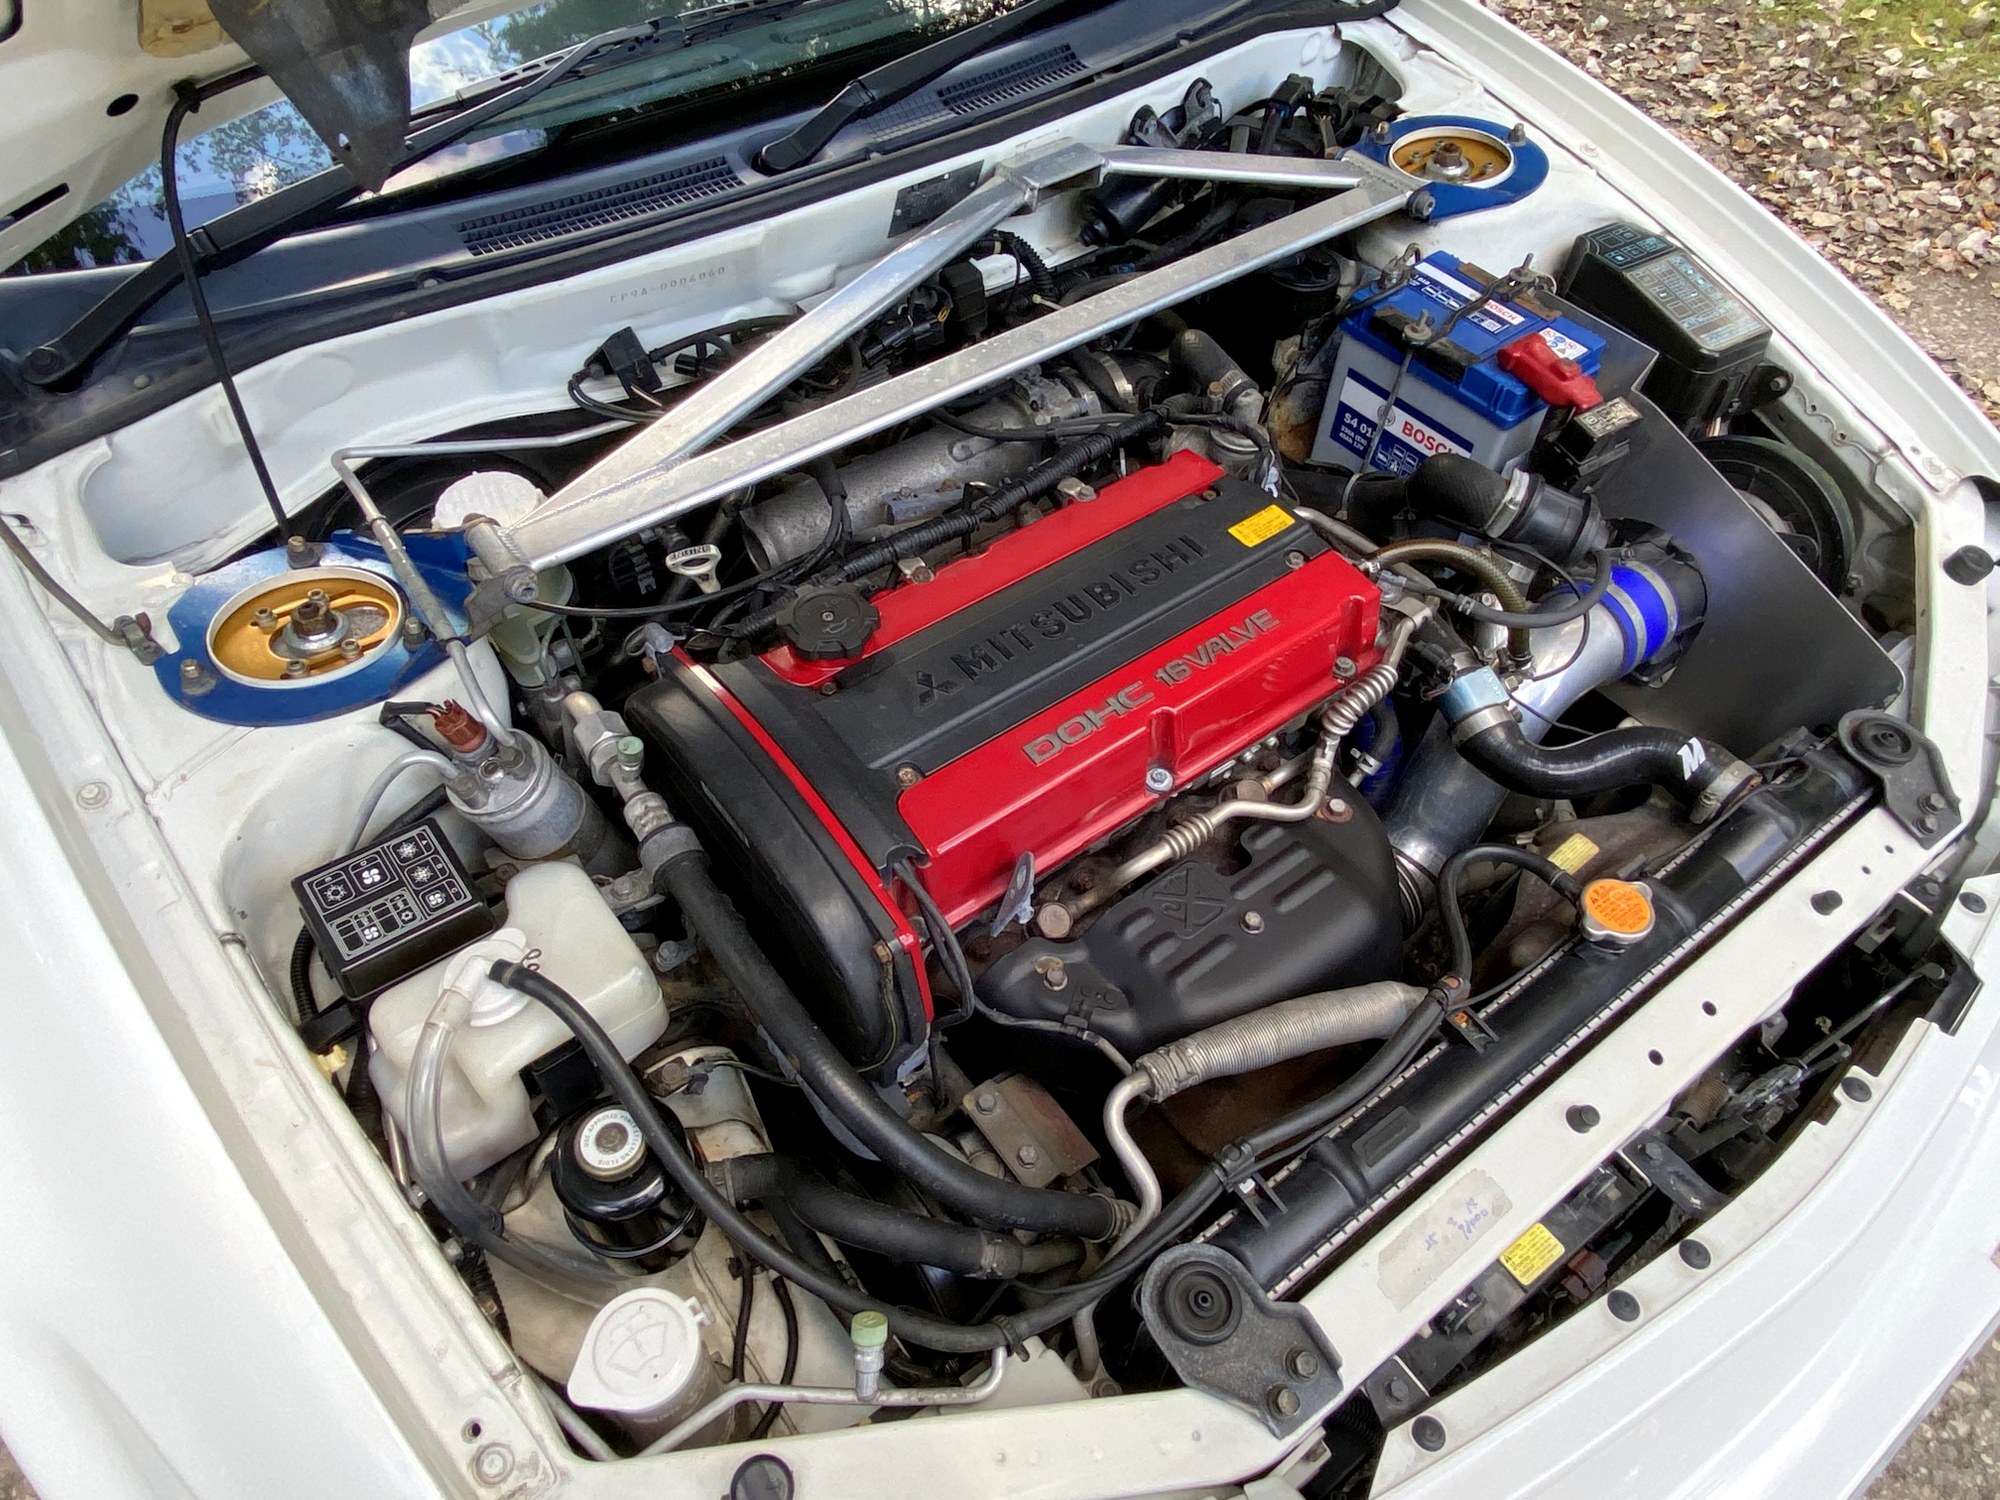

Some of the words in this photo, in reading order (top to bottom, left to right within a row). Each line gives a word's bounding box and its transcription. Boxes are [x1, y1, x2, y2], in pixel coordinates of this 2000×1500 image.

[1343, 413, 1358, 428] S4
[1360, 424, 1376, 438] 01
[1402, 420, 1453, 454] BOSC
[951, 533, 1208, 682] MITSUBISHI
[1022, 680, 1155, 766] DOHC
[1154, 608, 1281, 687] 16VALVE
